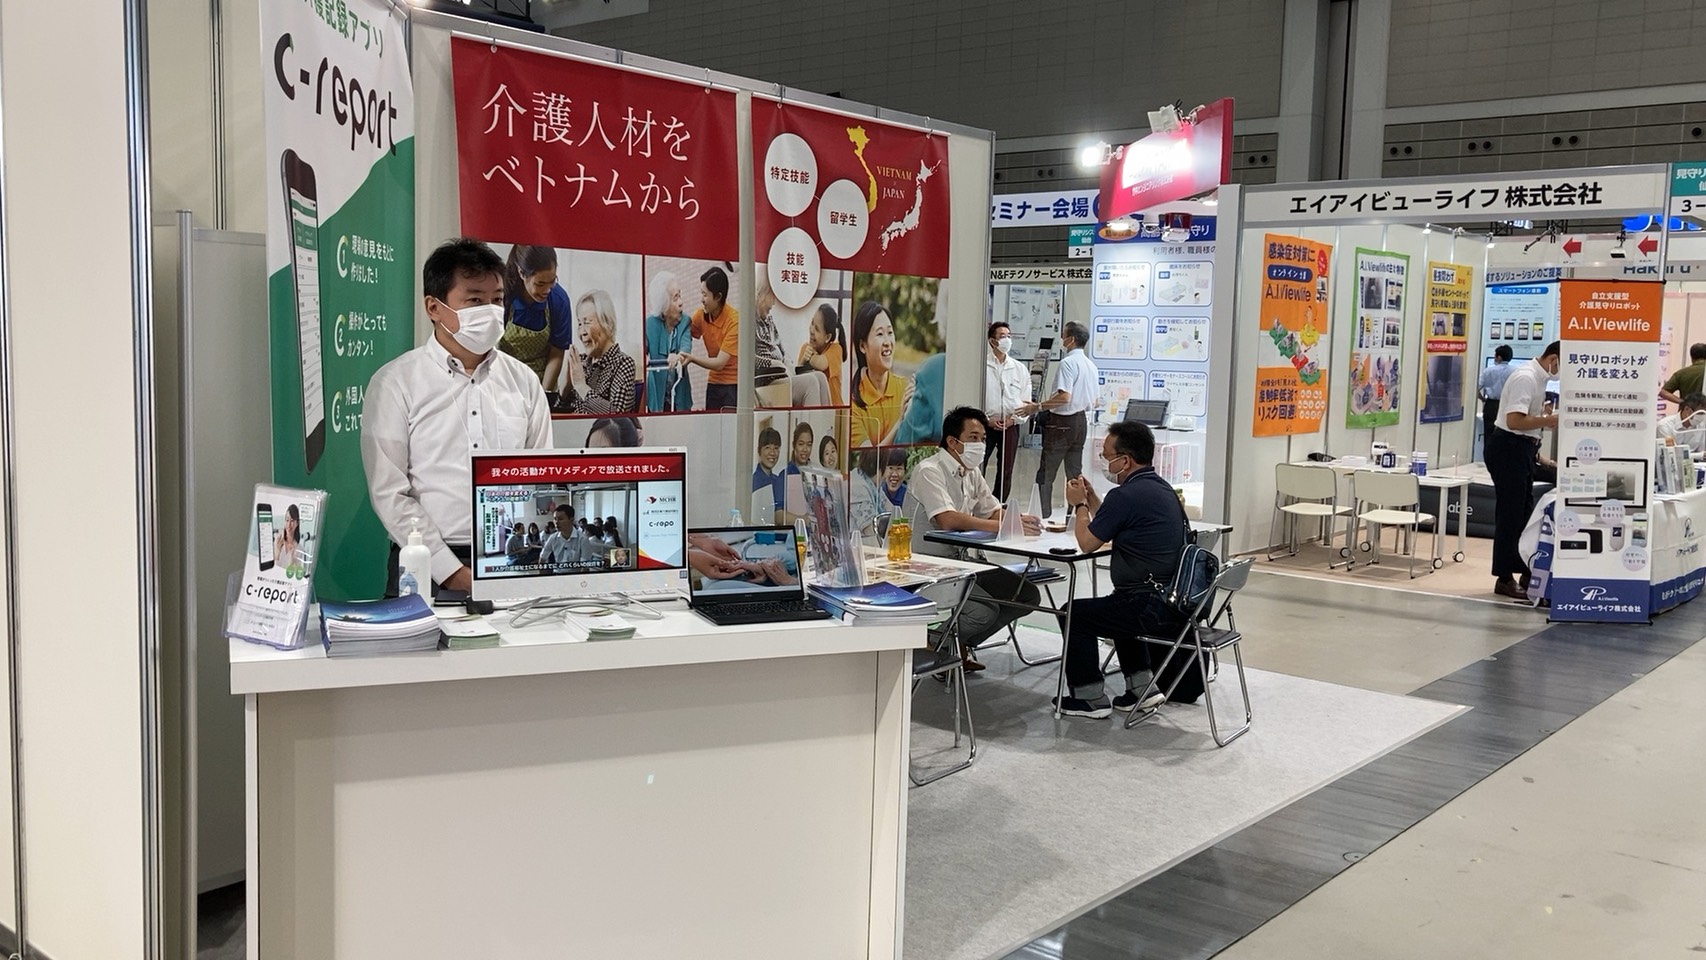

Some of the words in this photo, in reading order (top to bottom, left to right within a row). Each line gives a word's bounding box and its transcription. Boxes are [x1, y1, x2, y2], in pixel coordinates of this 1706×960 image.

[274, 33, 397, 156] c-report
[481, 83, 691, 161] 介護人材を
[770, 166, 810, 185] 特定技能
[876, 165, 912, 181] VIETNAM
[482, 155, 700, 220] ベトナムから
[882, 187, 905, 200] JAPAN
[1290, 182, 1602, 214] エイアイビューライフ株式会社
[830, 210, 857, 227] 留学生
[786, 252, 805, 266] 技能
[781, 269, 808, 284] 実習生
[1579, 301, 1641, 310] 介護見守りロボット
[1568, 316, 1651, 332] A.I.Viewlife
[1568, 353, 1648, 366] 見守りロボットが
[1577, 367, 1639, 380] 介護を変える
[491, 464, 670, 478] 我々の活動がTVメディアで放送されました。
[1448, 501, 1473, 515] abe
[246, 584, 298, 604] c-report
[1557, 603, 1641, 613] エイアイビューライフ株式会社
